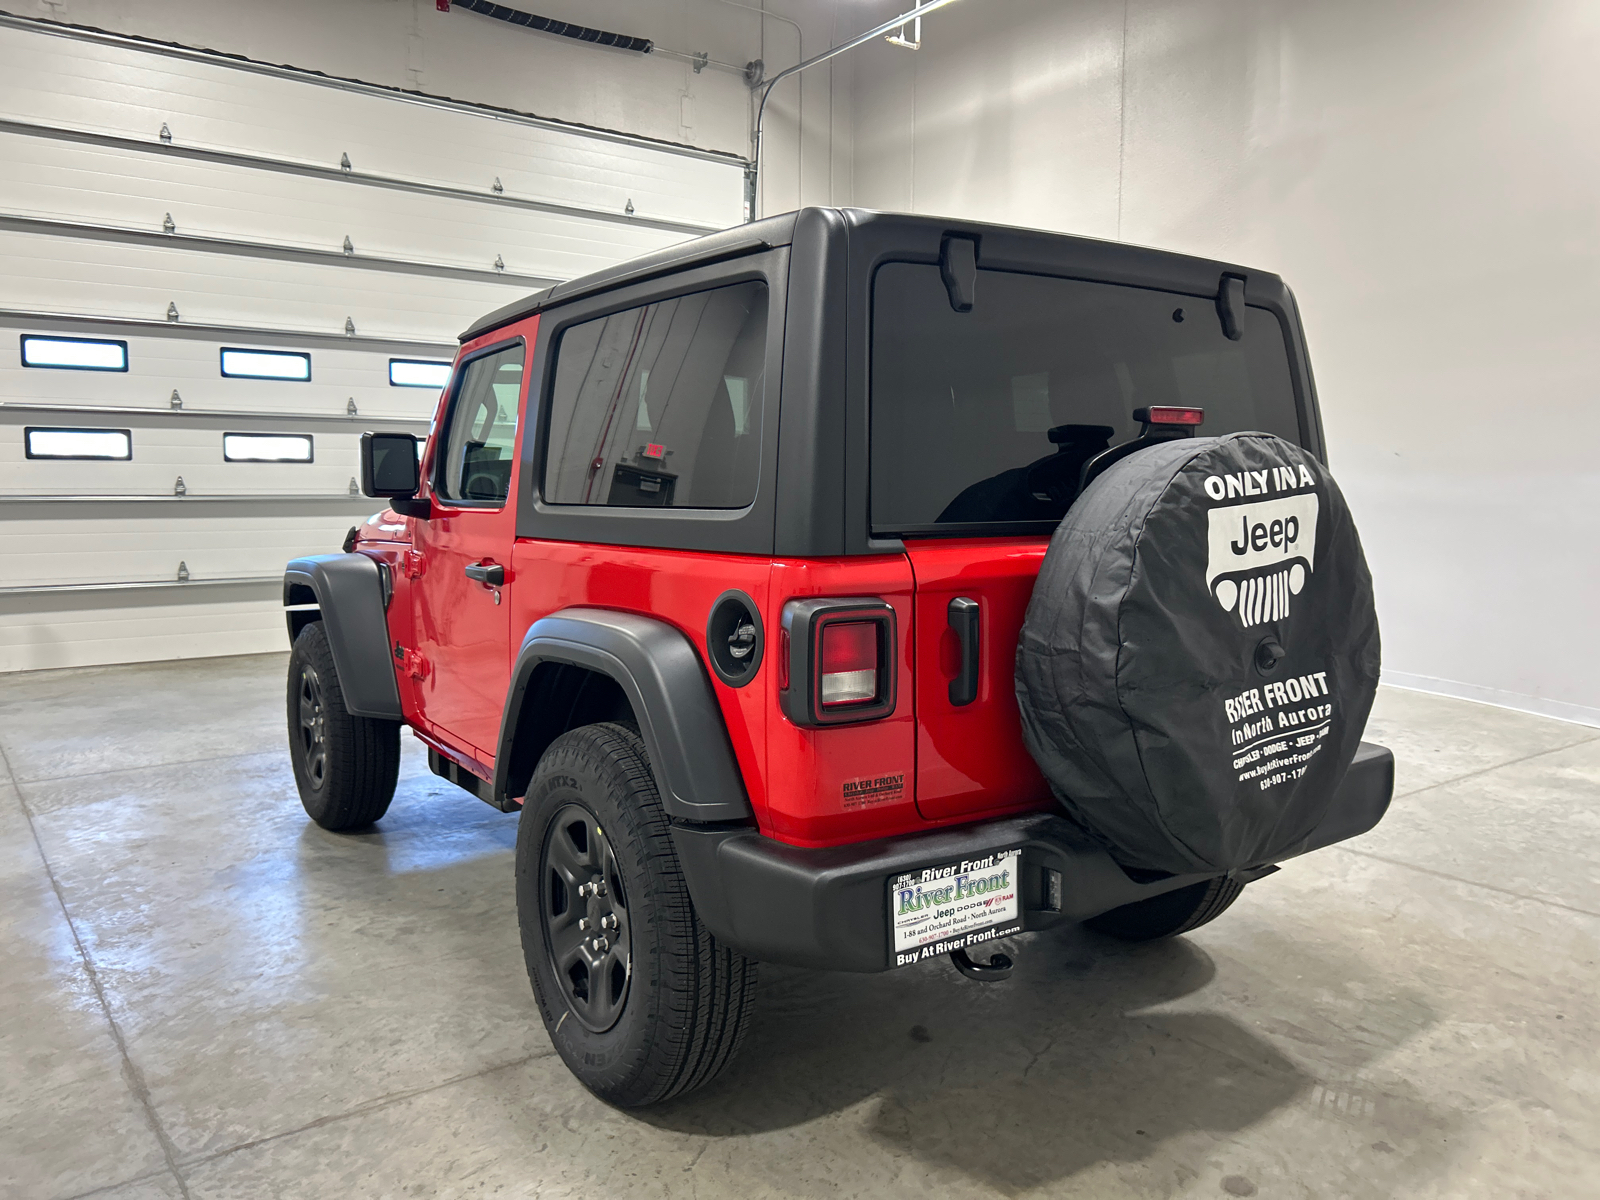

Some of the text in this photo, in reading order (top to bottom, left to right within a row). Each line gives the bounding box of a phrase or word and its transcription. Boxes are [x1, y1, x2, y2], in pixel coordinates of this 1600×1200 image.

[1204, 464, 1315, 501] ONLY IN A
[1231, 515, 1299, 556] Jeep
[1263, 671, 1329, 708] FRONT
[1231, 703, 1332, 745] In North Aurora
[1263, 741, 1289, 756] DODGE
[1295, 734, 1316, 748] JEEP
[843, 780, 872, 791] RIVER
[874, 774, 904, 787] FRONT
[921, 865, 957, 882] River
[960, 855, 994, 873] Front
[898, 869, 1010, 916] River Front
[957, 900, 988, 912] DODGE
[1002, 893, 1014, 901] RAM
[917, 925, 927, 935] and
[929, 919, 951, 932] Orchard
[952, 915, 967, 926] Road
[971, 912, 987, 921] North
[988, 906, 1006, 916] Aurora
[933, 907, 955, 920] Jeep
[897, 950, 919, 966] Buy
[921, 946, 934, 958] At
[935, 938, 965, 955] River
